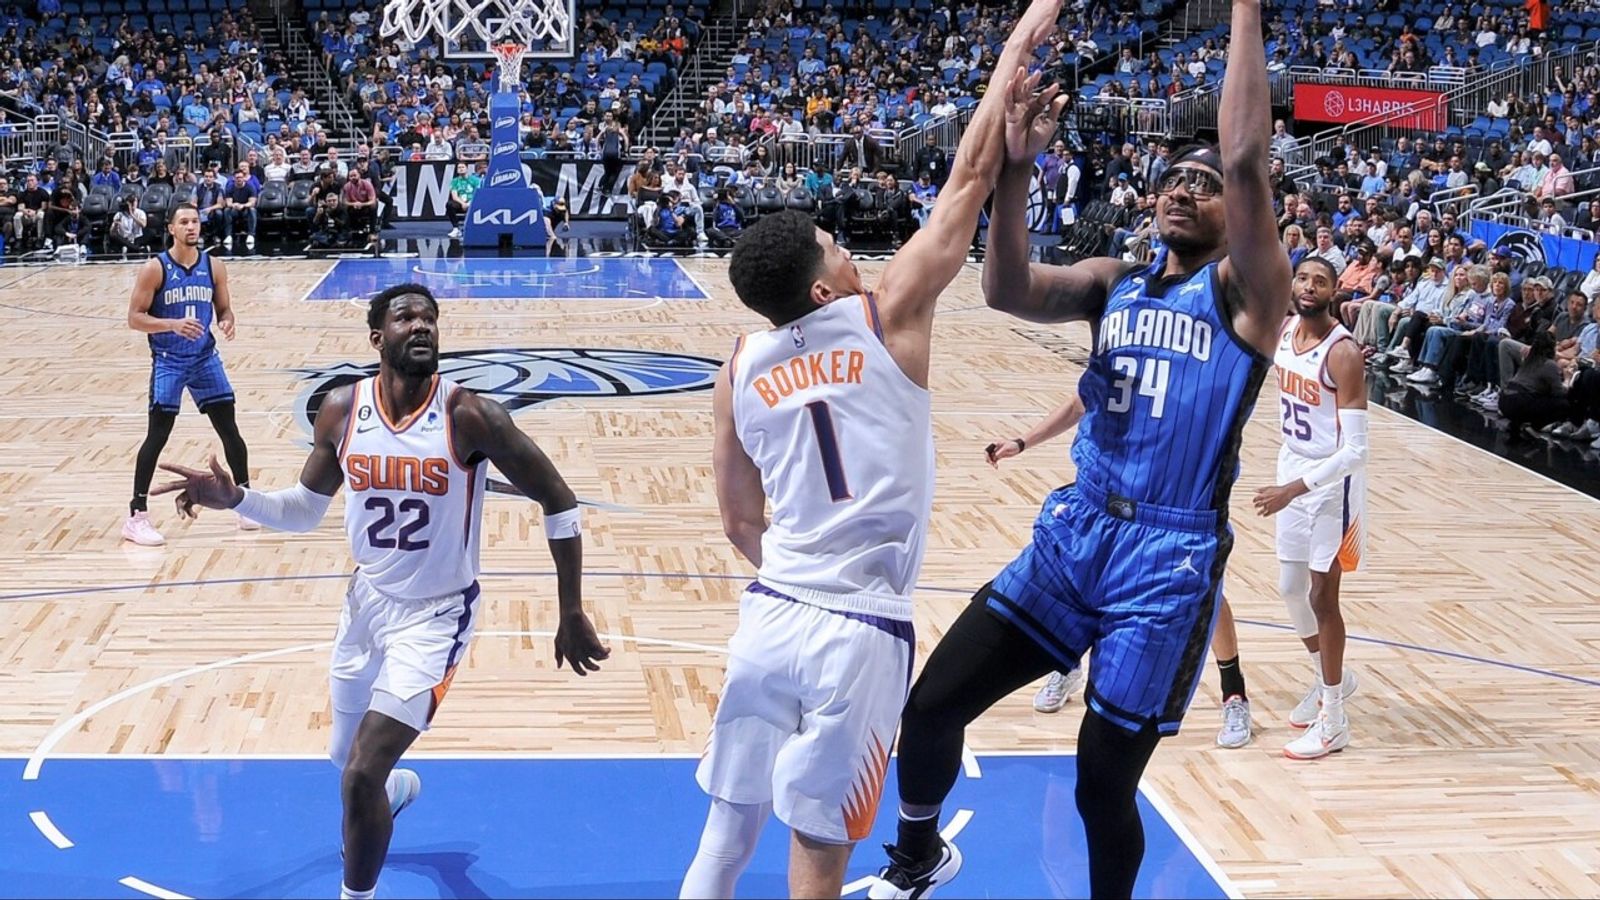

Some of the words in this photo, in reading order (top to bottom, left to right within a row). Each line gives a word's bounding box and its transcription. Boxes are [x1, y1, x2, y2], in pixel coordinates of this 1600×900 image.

[1348, 97, 1414, 116] L3HARRIS
[473, 209, 538, 225] KIA
[164, 285, 213, 305] ORLANDO
[1098, 308, 1212, 362] ORLANDO
[752, 350, 864, 409] BOOKER
[1107, 356, 1171, 418] 34
[359, 406, 372, 421] 6
[1281, 397, 1312, 441] 25
[804, 400, 853, 502] 1
[346, 454, 449, 496] SUNS
[364, 497, 430, 551] 22
